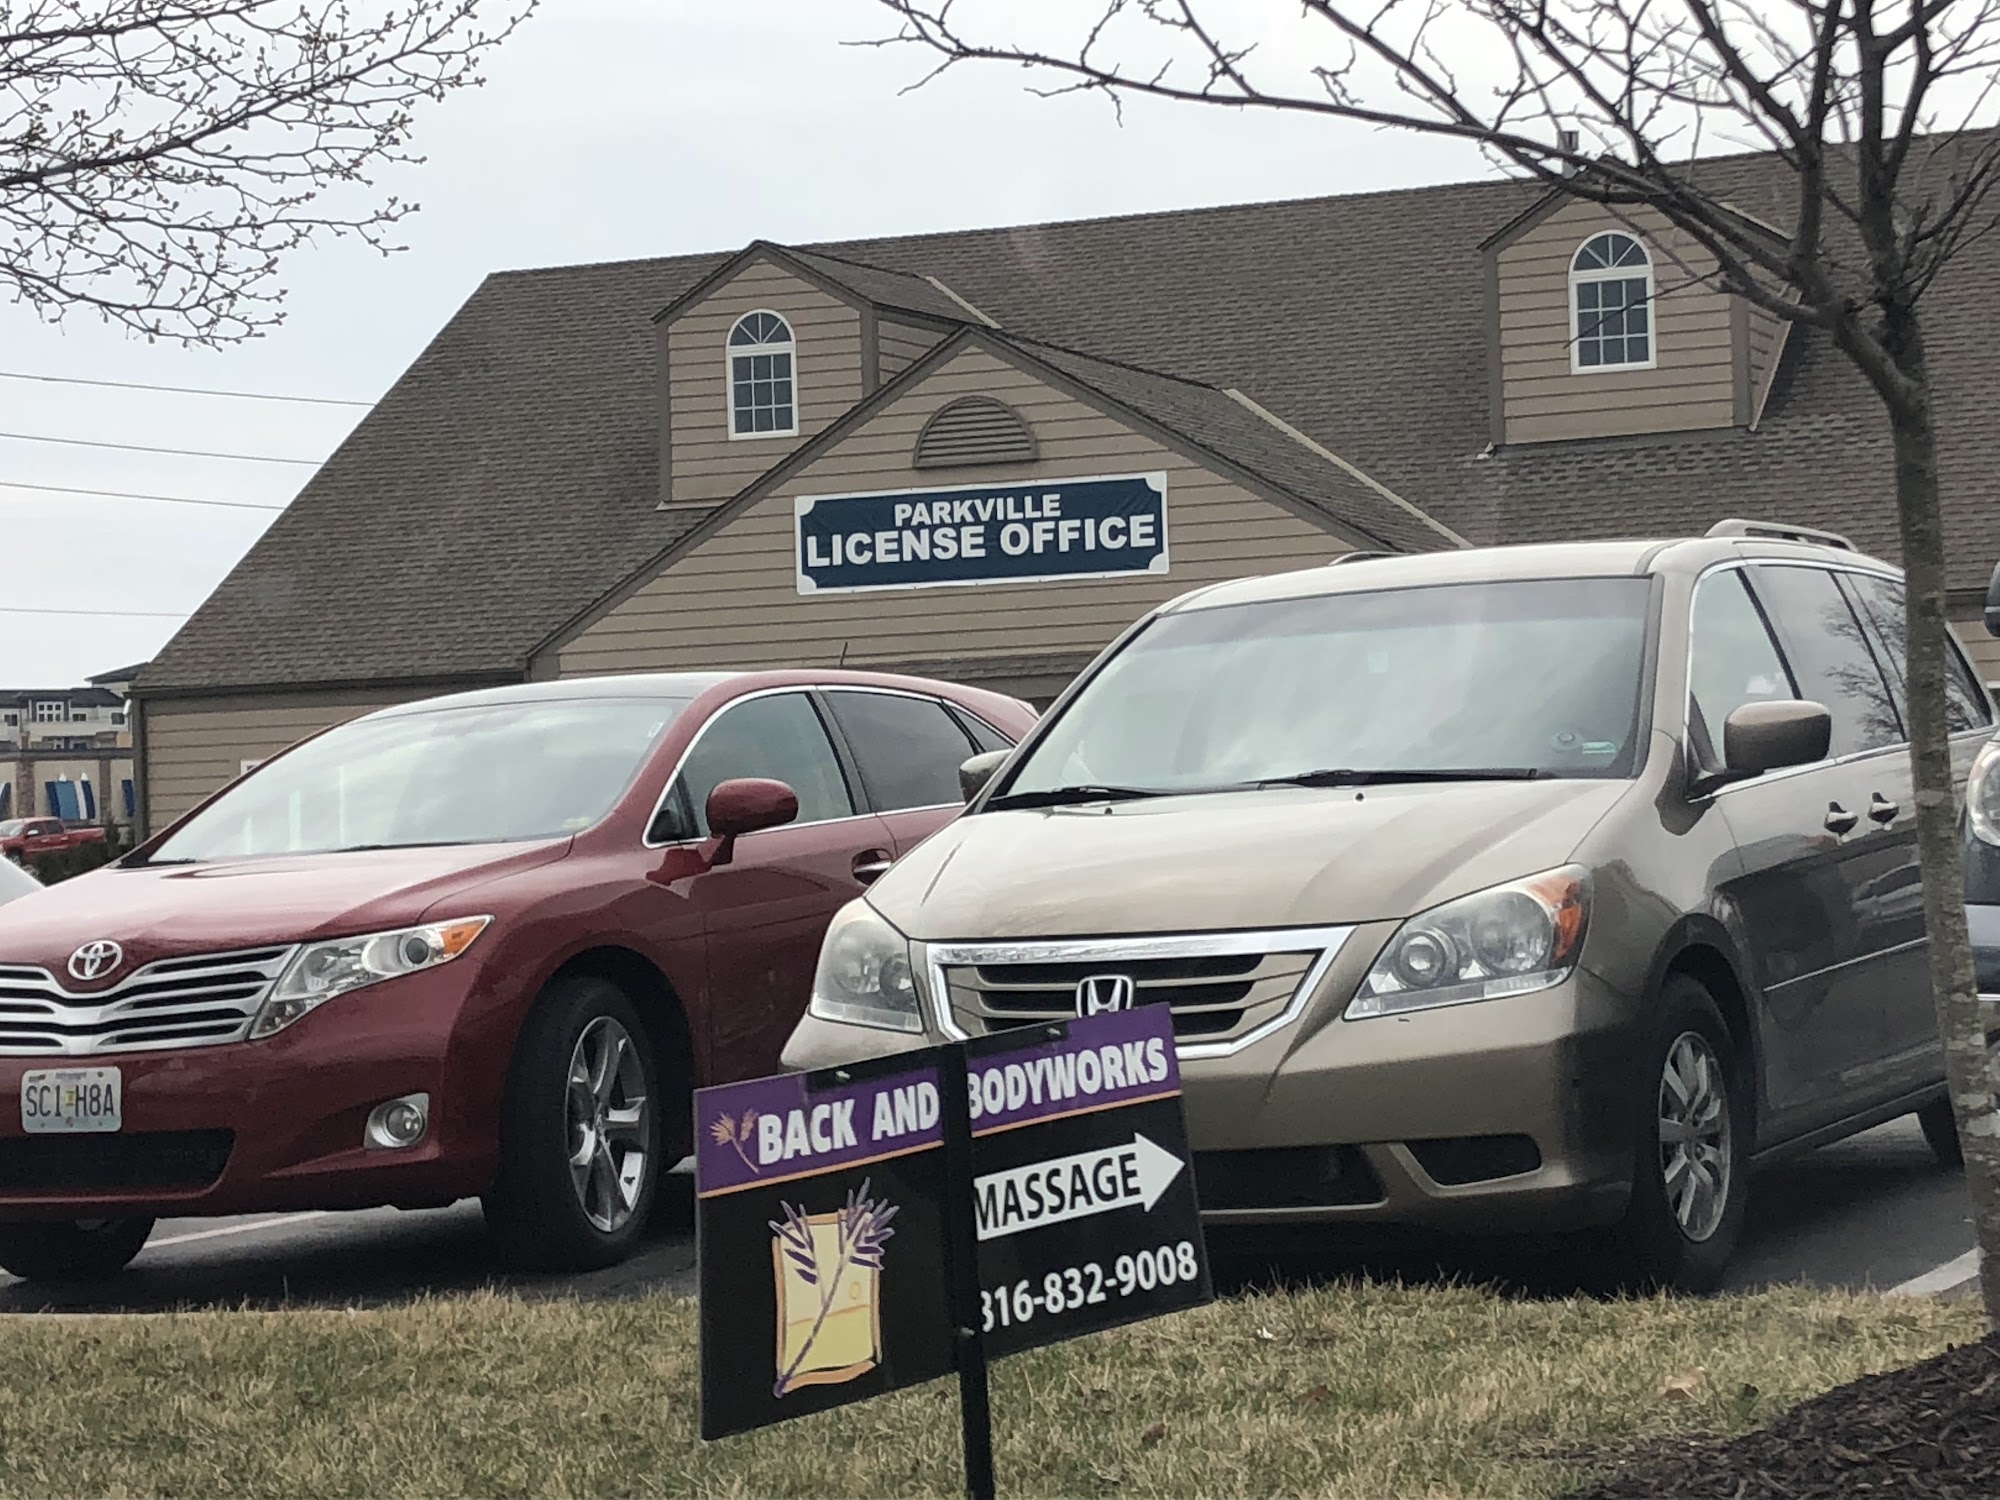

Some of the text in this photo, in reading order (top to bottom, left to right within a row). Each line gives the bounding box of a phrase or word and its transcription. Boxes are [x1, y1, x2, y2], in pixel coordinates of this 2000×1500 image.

[806, 513, 1156, 568] LICENSE OFFICE
[894, 494, 1061, 527] PARKVILLE
[758, 1037, 1168, 1166] BACK AND BODYWORKS
[974, 1152, 1142, 1231] MASSAGE
